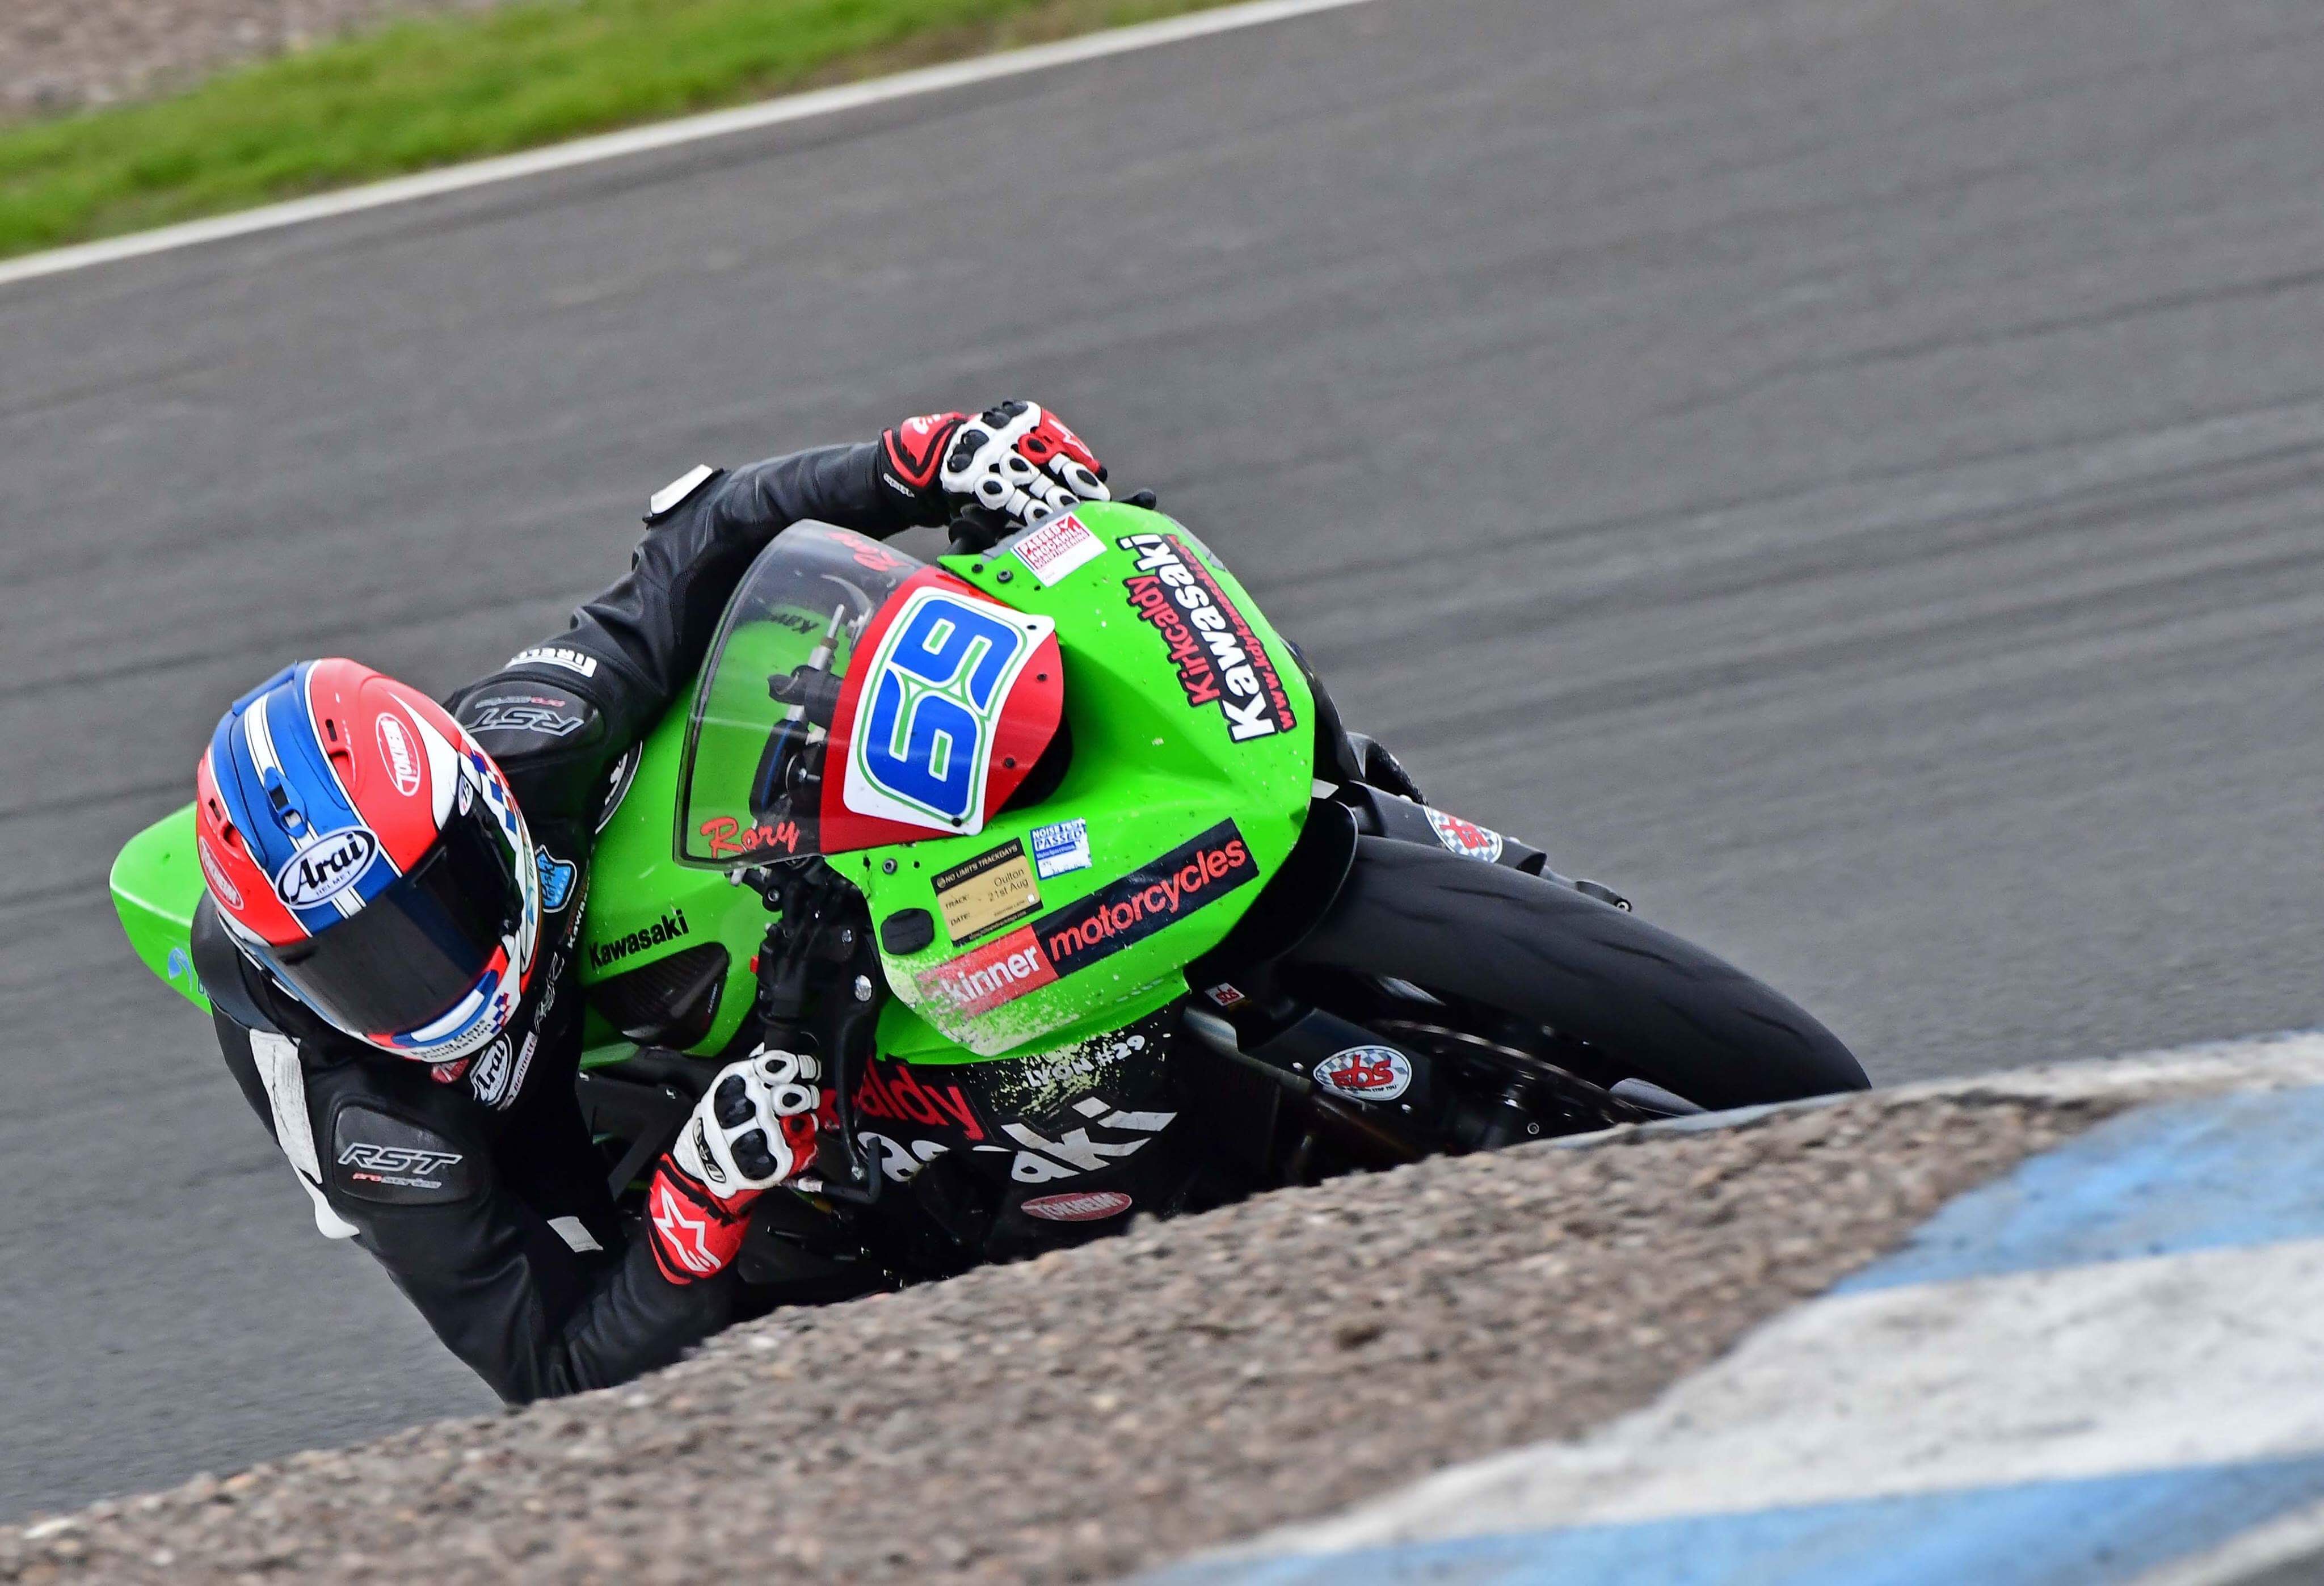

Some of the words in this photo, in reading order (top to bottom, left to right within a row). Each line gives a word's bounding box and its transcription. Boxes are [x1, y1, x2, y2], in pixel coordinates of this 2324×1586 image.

[1018, 523, 1062, 556] PASSED
[1026, 523, 1084, 563] KNOCKHILL
[1119, 534, 1275, 740] Kawasaki
[1126, 577, 1220, 705] Kirkcaldy
[465, 708, 584, 736] RST
[866, 599, 1019, 810] 69
[701, 817, 800, 859] Rory
[291, 832, 365, 903] Arai
[315, 869, 351, 896] HELMET
[944, 873, 956, 884] NO
[954, 863, 979, 878] LIMITS
[978, 844, 1018, 867] TRACKDAYS
[992, 867, 1025, 887] Oulton
[987, 886, 1008, 902] 21st
[1008, 878, 1029, 893] Aug
[1049, 839, 1246, 961] motorcycles
[589, 908, 690, 971] Kawasaki
[475, 1042, 505, 1100] Arai
[1025, 1054, 1094, 1086] LYON
[1093, 1033, 1144, 1066] #29
[1330, 1055, 1393, 1086] sbs
[337, 1142, 463, 1175] RST
